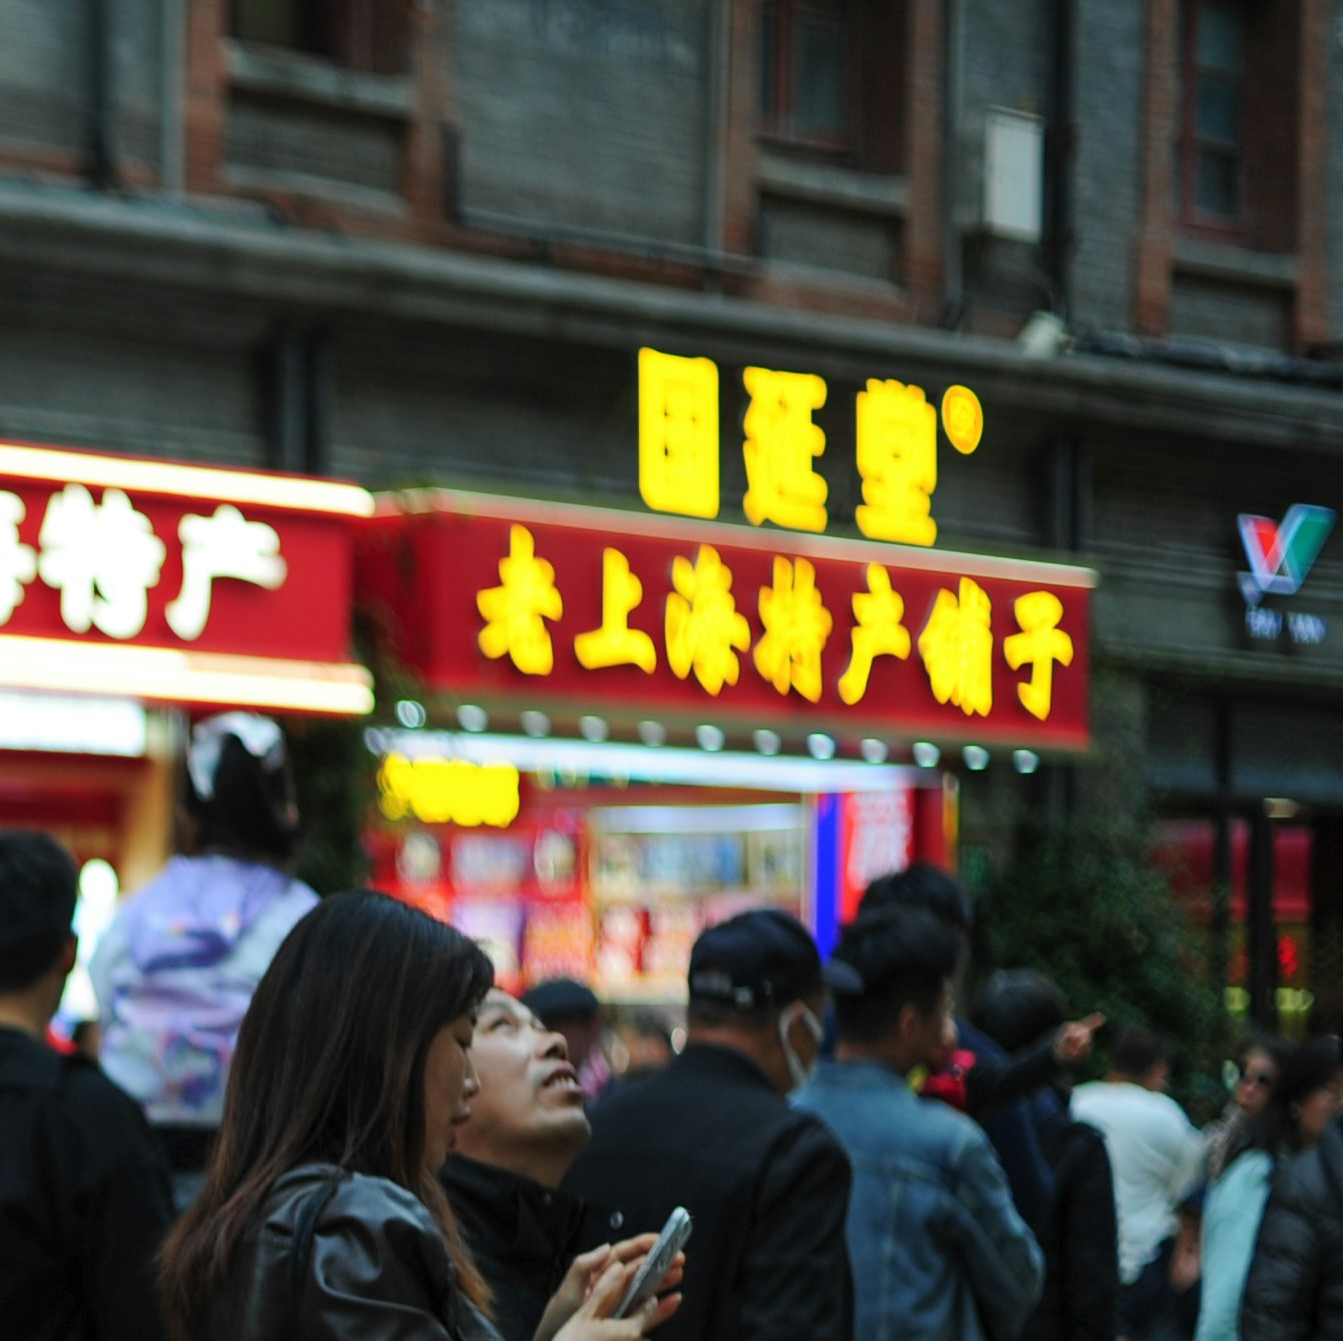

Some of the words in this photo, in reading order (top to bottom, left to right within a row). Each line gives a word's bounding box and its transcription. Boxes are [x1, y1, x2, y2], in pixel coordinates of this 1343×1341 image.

[476, 522, 1075, 721] 老上海特产铺子
